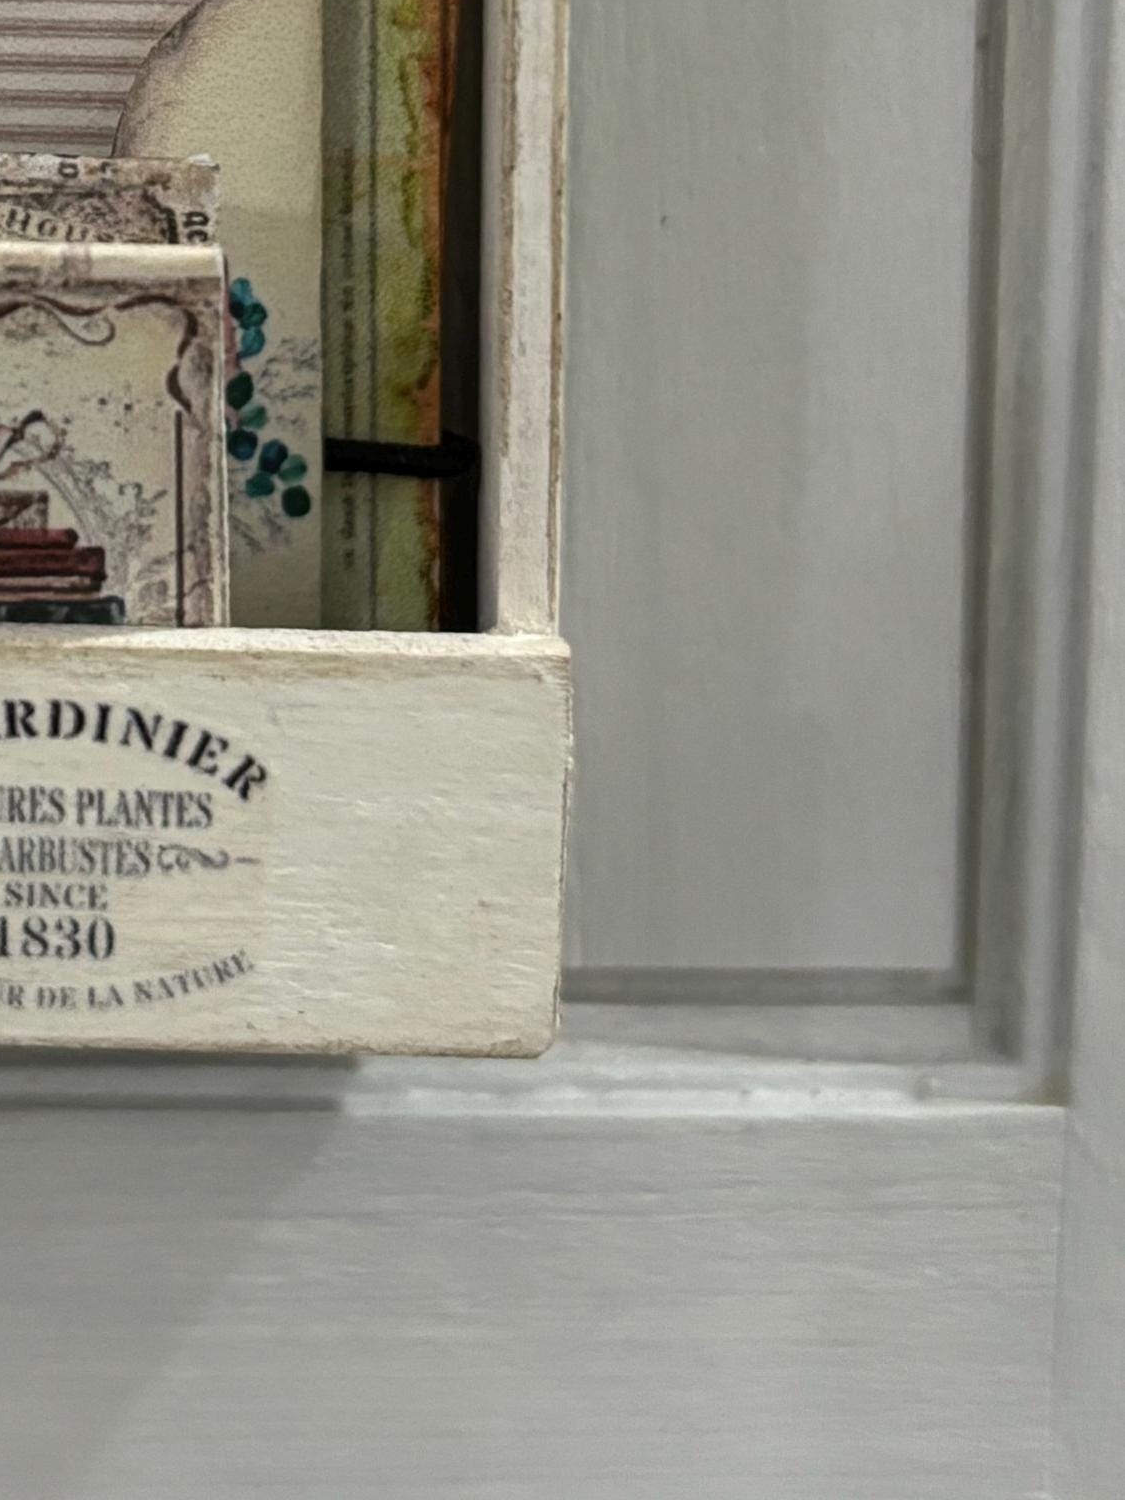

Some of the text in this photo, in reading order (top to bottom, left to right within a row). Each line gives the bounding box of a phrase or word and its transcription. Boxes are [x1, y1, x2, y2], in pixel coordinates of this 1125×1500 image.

[76, 788, 213, 829] PLANTES
[4, 882, 109, 910] SINCE
[36, 986, 77, 1010] DE
[87, 985, 123, 1010] LA
[134, 950, 255, 1006] NATURE
